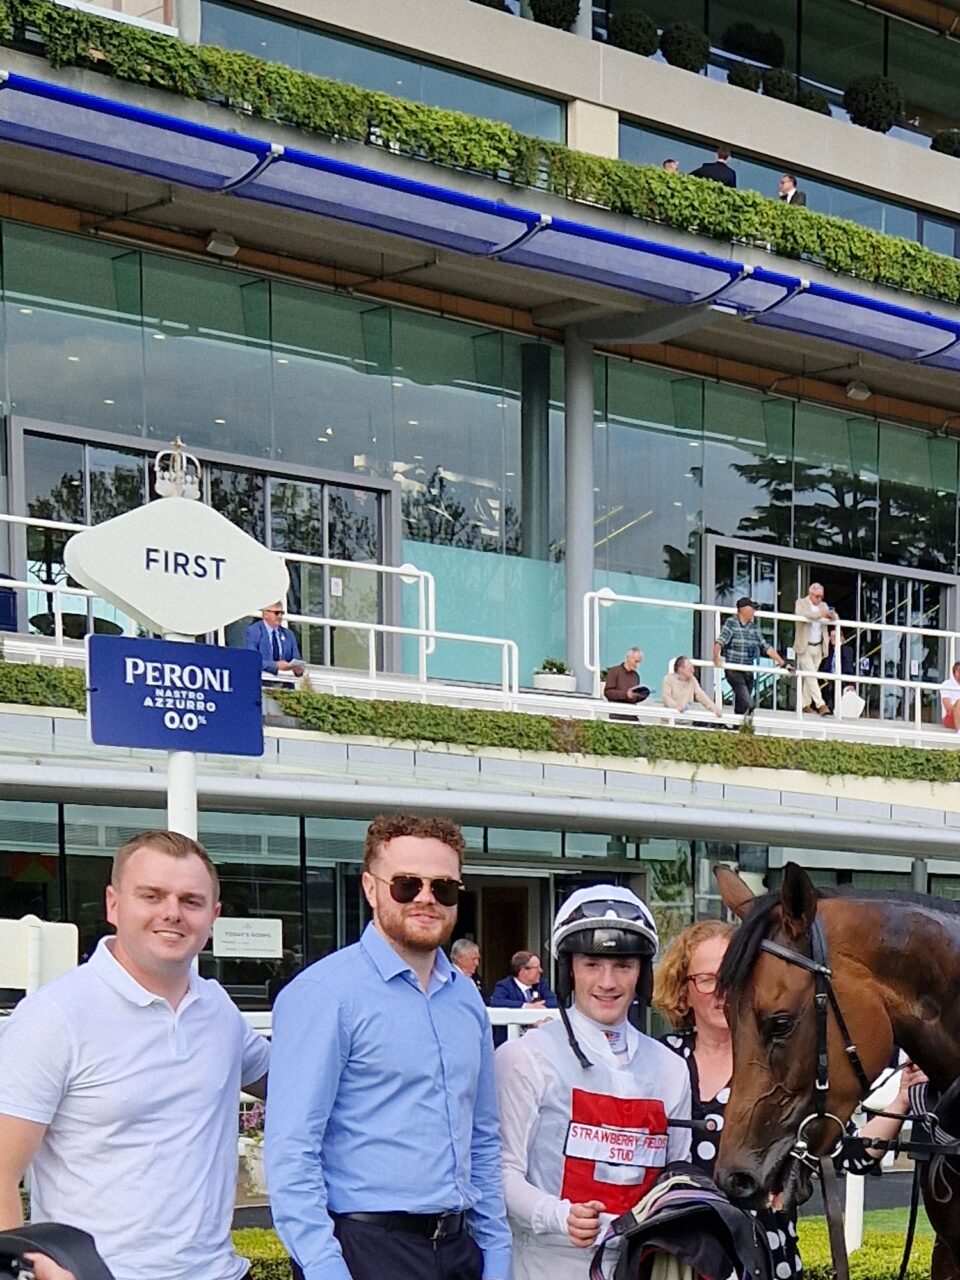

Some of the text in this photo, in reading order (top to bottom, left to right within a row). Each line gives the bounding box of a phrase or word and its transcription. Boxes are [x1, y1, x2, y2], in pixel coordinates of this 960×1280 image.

[146, 548, 226, 580] FIRST
[125, 657, 231, 692] PERONI
[155, 688, 205, 700] NASTRO
[143, 697, 217, 712] AZZURRO
[164, 711, 207, 731] 0.0%
[572, 1126, 640, 1148] STRAWBERRY
[609, 1147, 634, 1162] STUD
